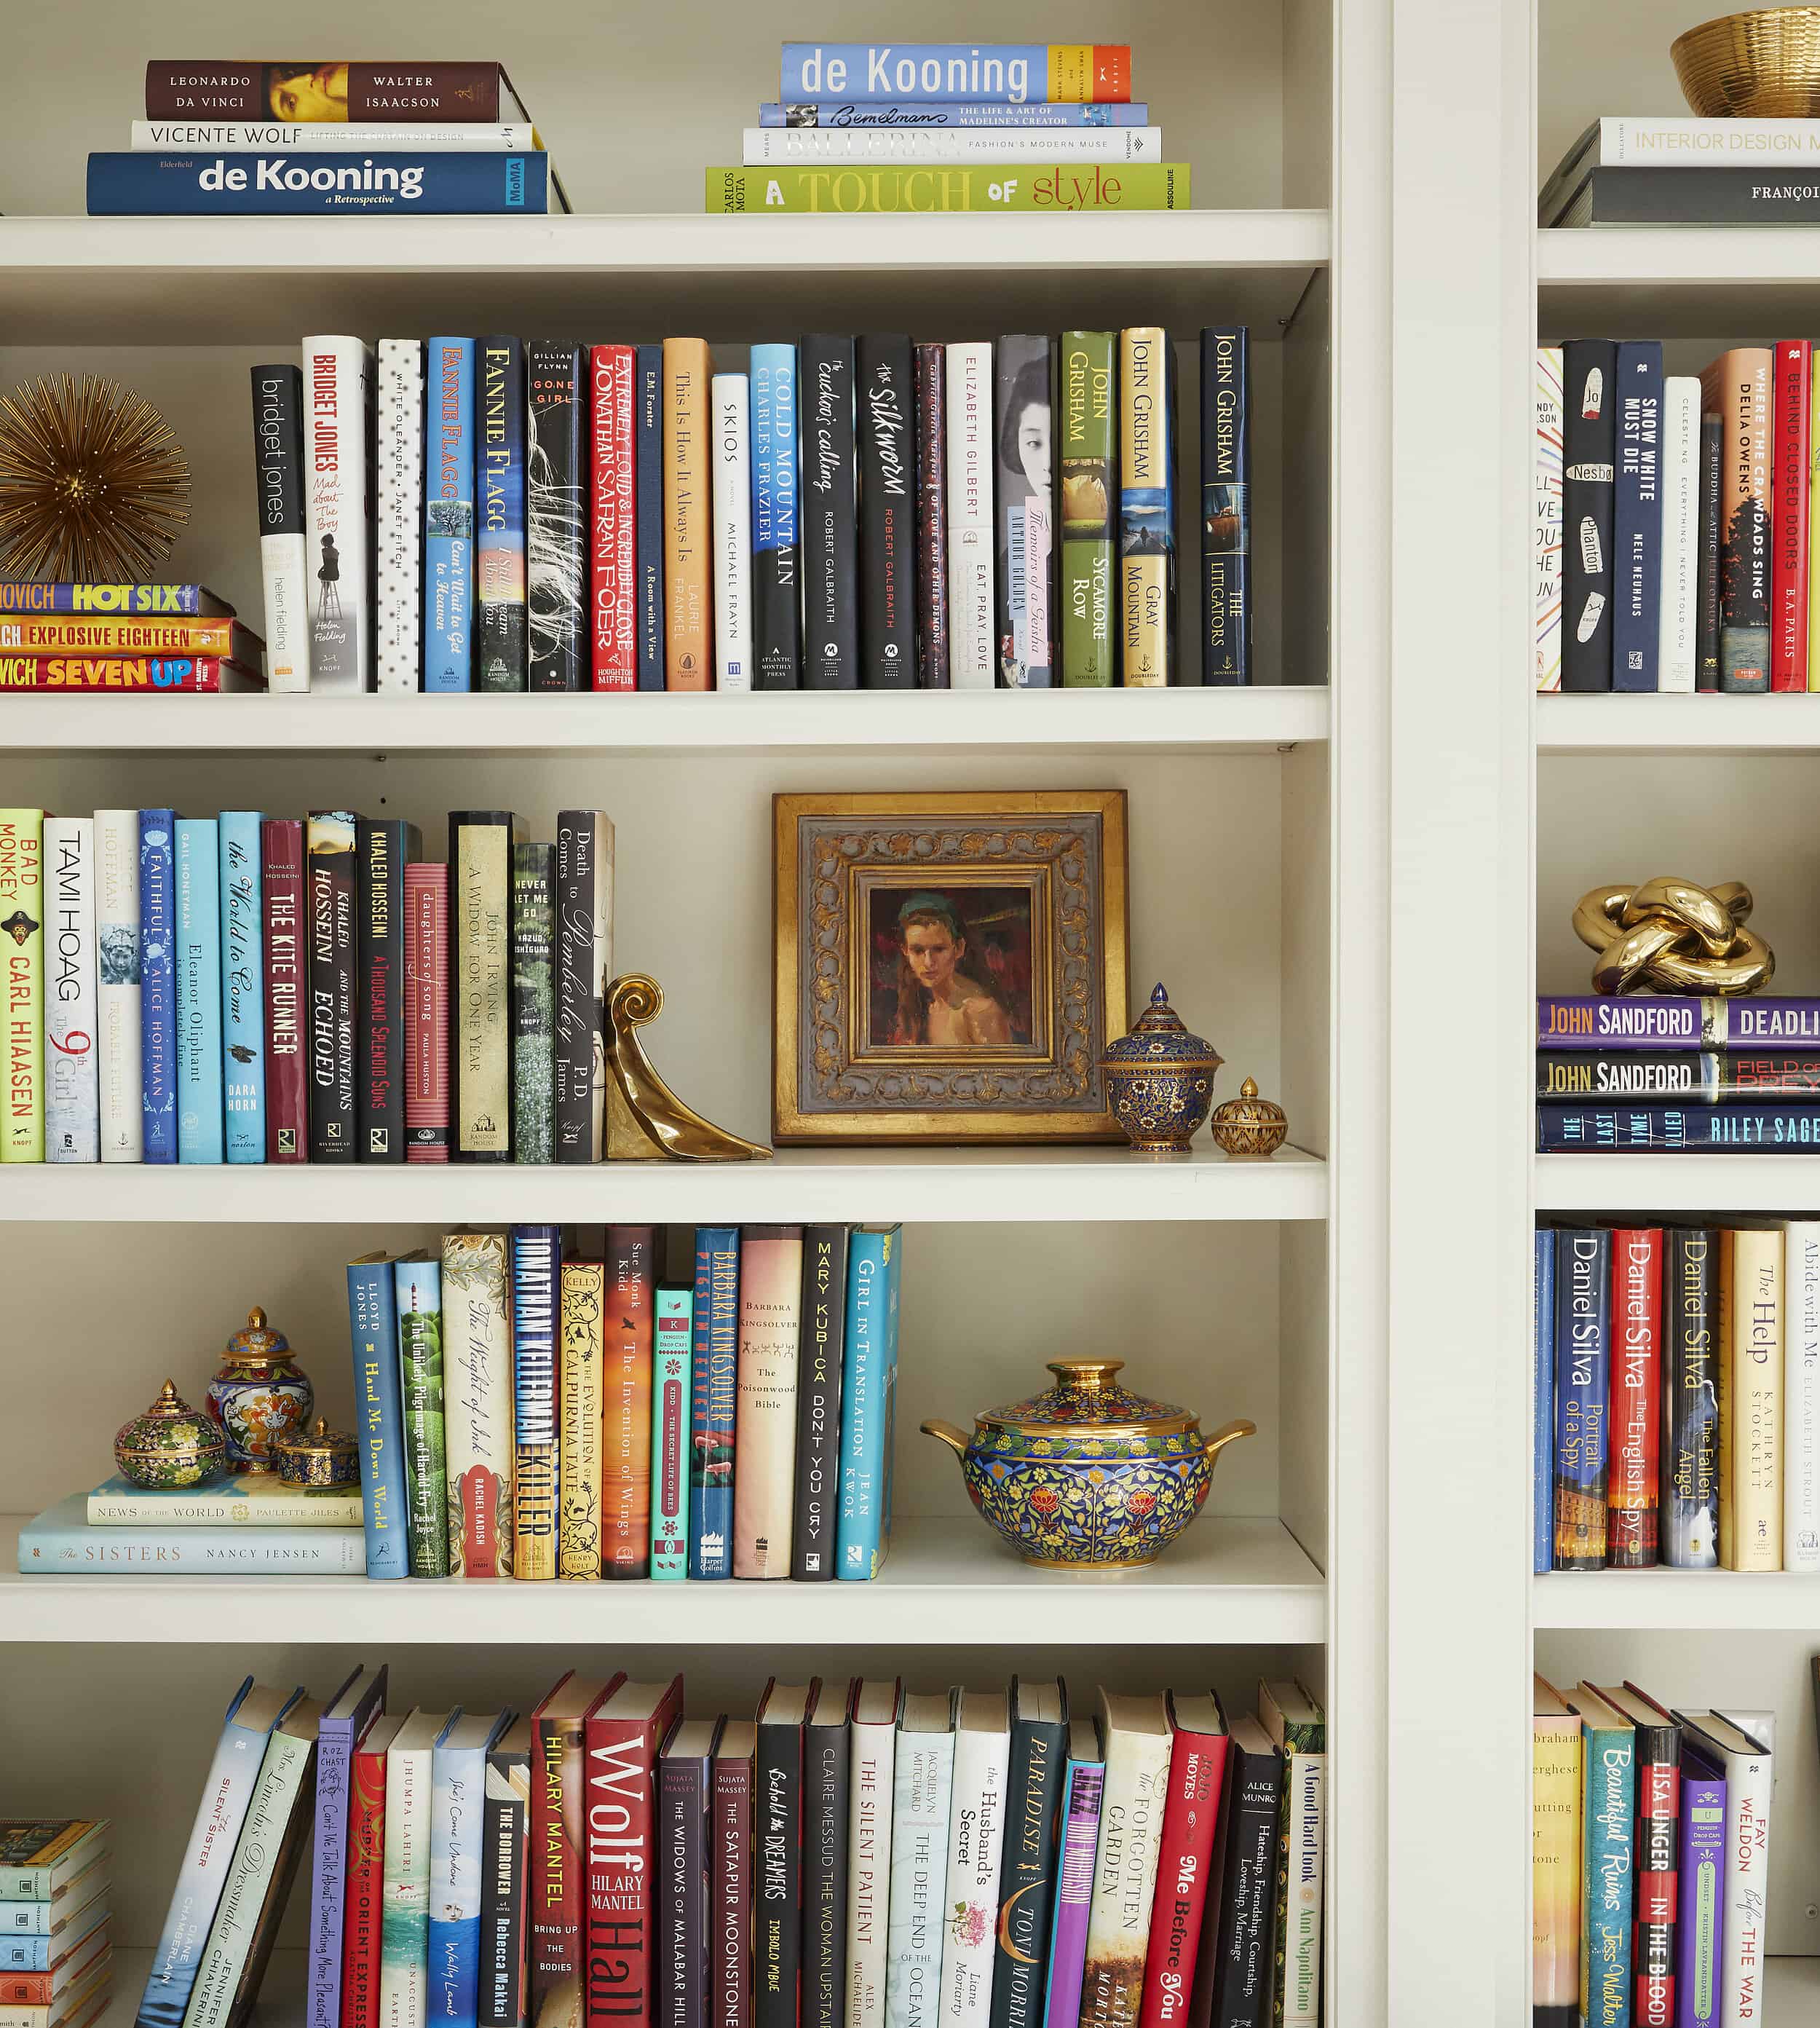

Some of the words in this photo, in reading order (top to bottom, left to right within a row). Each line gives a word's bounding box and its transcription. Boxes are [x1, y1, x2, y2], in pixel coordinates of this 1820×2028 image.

[170, 76, 250, 87] LEONARDO
[373, 76, 433, 87] WALTER
[802, 49, 844, 93] de
[868, 49, 1028, 103] Kooning
[176, 97, 194, 108] DA
[202, 97, 245, 108] VINCI
[365, 97, 440, 108] ISAACSON
[831, 106, 948, 126] Bemelmans
[959, 106, 978, 115] THE
[982, 106, 1003, 115] LIFE
[1006, 106, 1013, 115] &
[1017, 106, 1034, 115] ART
[1040, 106, 1053, 115] OF
[959, 116, 1019, 125] MADELINE'S
[1022, 116, 1068, 125] CREATOR
[151, 127, 237, 144] VICENTE
[244, 127, 303, 144] WOLF
[969, 140, 1025, 149] FASHION'S
[1030, 140, 1075, 149] MODERN
[1079, 140, 1108, 149] MUSE
[1636, 133, 1723, 149] INTERIOR
[1730, 133, 1800, 150] DESIGN
[159, 160, 193, 168] Elderfield
[198, 159, 248, 192] de
[256, 159, 424, 199] Kooning
[510, 162, 522, 202] MoMA
[334, 194, 394, 205] Retrospective
[735, 177, 745, 210] MOTA
[767, 180, 785, 205] A
[799, 170, 976, 213] TOUCH
[989, 179, 1018, 203] OF
[1033, 166, 1122, 210] style
[1214, 334, 1235, 383] JOHN
[534, 381, 574, 390] GONE
[537, 396, 571, 404] GIRL
[260, 379, 288, 460] bridget
[646, 395, 654, 428] Forster
[1624, 398, 1639, 443] MUST
[1642, 398, 1657, 443] SNOW
[724, 403, 737, 462] SKIOS
[1217, 390, 1236, 475] GRISHAM
[1623, 449, 1638, 474] DIE
[1640, 451, 1655, 501] WHITE
[1682, 451, 1688, 465] NG
[263, 466, 286, 523] jones
[824, 512, 834, 553] ROBERT
[1634, 534, 1644, 561] NELE
[727, 524, 738, 587] MICHAEL
[275, 577, 289, 608] helen
[647, 575, 655, 603] Room
[826, 559, 836, 623] GALBRAITH
[976, 565, 987, 592] EAT,
[1632, 567, 1642, 617] NEUHAUS
[74, 584, 134, 611] HOT
[137, 584, 182, 611] SIX
[976, 596, 987, 634] PRAY,
[1211, 563, 1226, 647] LITIGATORS
[1230, 590, 1242, 617] THE
[275, 610, 289, 650] fielding
[647, 606, 655, 626] with
[728, 595, 739, 639] FRAYN
[30, 627, 111, 647] EXPLOSIVE
[119, 627, 189, 647] EIGHTEEN
[647, 637, 655, 660] View
[978, 638, 987, 671] LOVE
[47, 659, 148, 686] SEVEN
[151, 659, 192, 687] UP
[57, 831, 80, 901] TAMI
[151, 855, 162, 935] FAITHFUL
[271, 894, 296, 927] THE
[58, 910, 81, 1001] HOAG
[272, 935, 296, 974] KITE
[10, 957, 31, 1010] CARL
[151, 968, 162, 1011] ALICE
[189, 944, 201, 1005] Eleanor
[273, 985, 298, 1054] RUNNER
[1548, 1005, 1592, 1033] JOHN
[1599, 1004, 1693, 1035] SANDFORD
[152, 1021, 163, 1096] HOFFMAN
[189, 1012, 202, 1083] Oliphant
[11, 1022, 32, 1116] HIAASEN
[558, 1057, 570, 1102] James
[574, 1065, 587, 1079] P.
[229, 1086, 256, 1095] DARA
[229, 1100, 256, 1110] HORN
[574, 1084, 587, 1100] D.
[1712, 1118, 1764, 1142] RILEY
[356, 1284, 366, 1330] JONES
[369, 1282, 379, 1330] LLOYD
[737, 1384, 795, 1392] Poisonwood
[1752, 1392, 1760, 1489] STOCKETT
[1764, 1392, 1773, 1488] KATHRYN
[475, 1478, 485, 1510] RACHEL
[668, 1477, 674, 1490] OF
[844, 1467, 855, 1518] KWOK
[860, 1474, 870, 1515] JEAN
[99, 1508, 138, 1517] NEWS
[174, 1508, 225, 1517] WORLD
[477, 1514, 486, 1544] KADISH
[86, 1546, 182, 1561] SISTERS
[207, 1550, 257, 1558] NANCY
[266, 1550, 320, 1558] JENSEN
[212, 1778, 230, 1820] SILENT
[403, 1760, 413, 1816] JHUMPA
[1242, 1794, 1276, 1802] MUNRO
[1653, 1762, 1670, 1802] LISA
[500, 1807, 513, 1828] THE
[199, 1824, 216, 1867] SISTER
[403, 1824, 412, 1872] LAHIRI
[1651, 1809, 1669, 1871] UNGER
[498, 1832, 513, 1894] BORROWER
[1299, 1908, 1315, 1933] Ann
[769, 1920, 780, 1960] IMBOLO
[768, 1964, 780, 1992] MBUE
[951, 1962, 966, 2016] Moriarty
[968, 1973, 980, 2007] Liane
[1296, 1937, 1315, 2011] Napolitano
